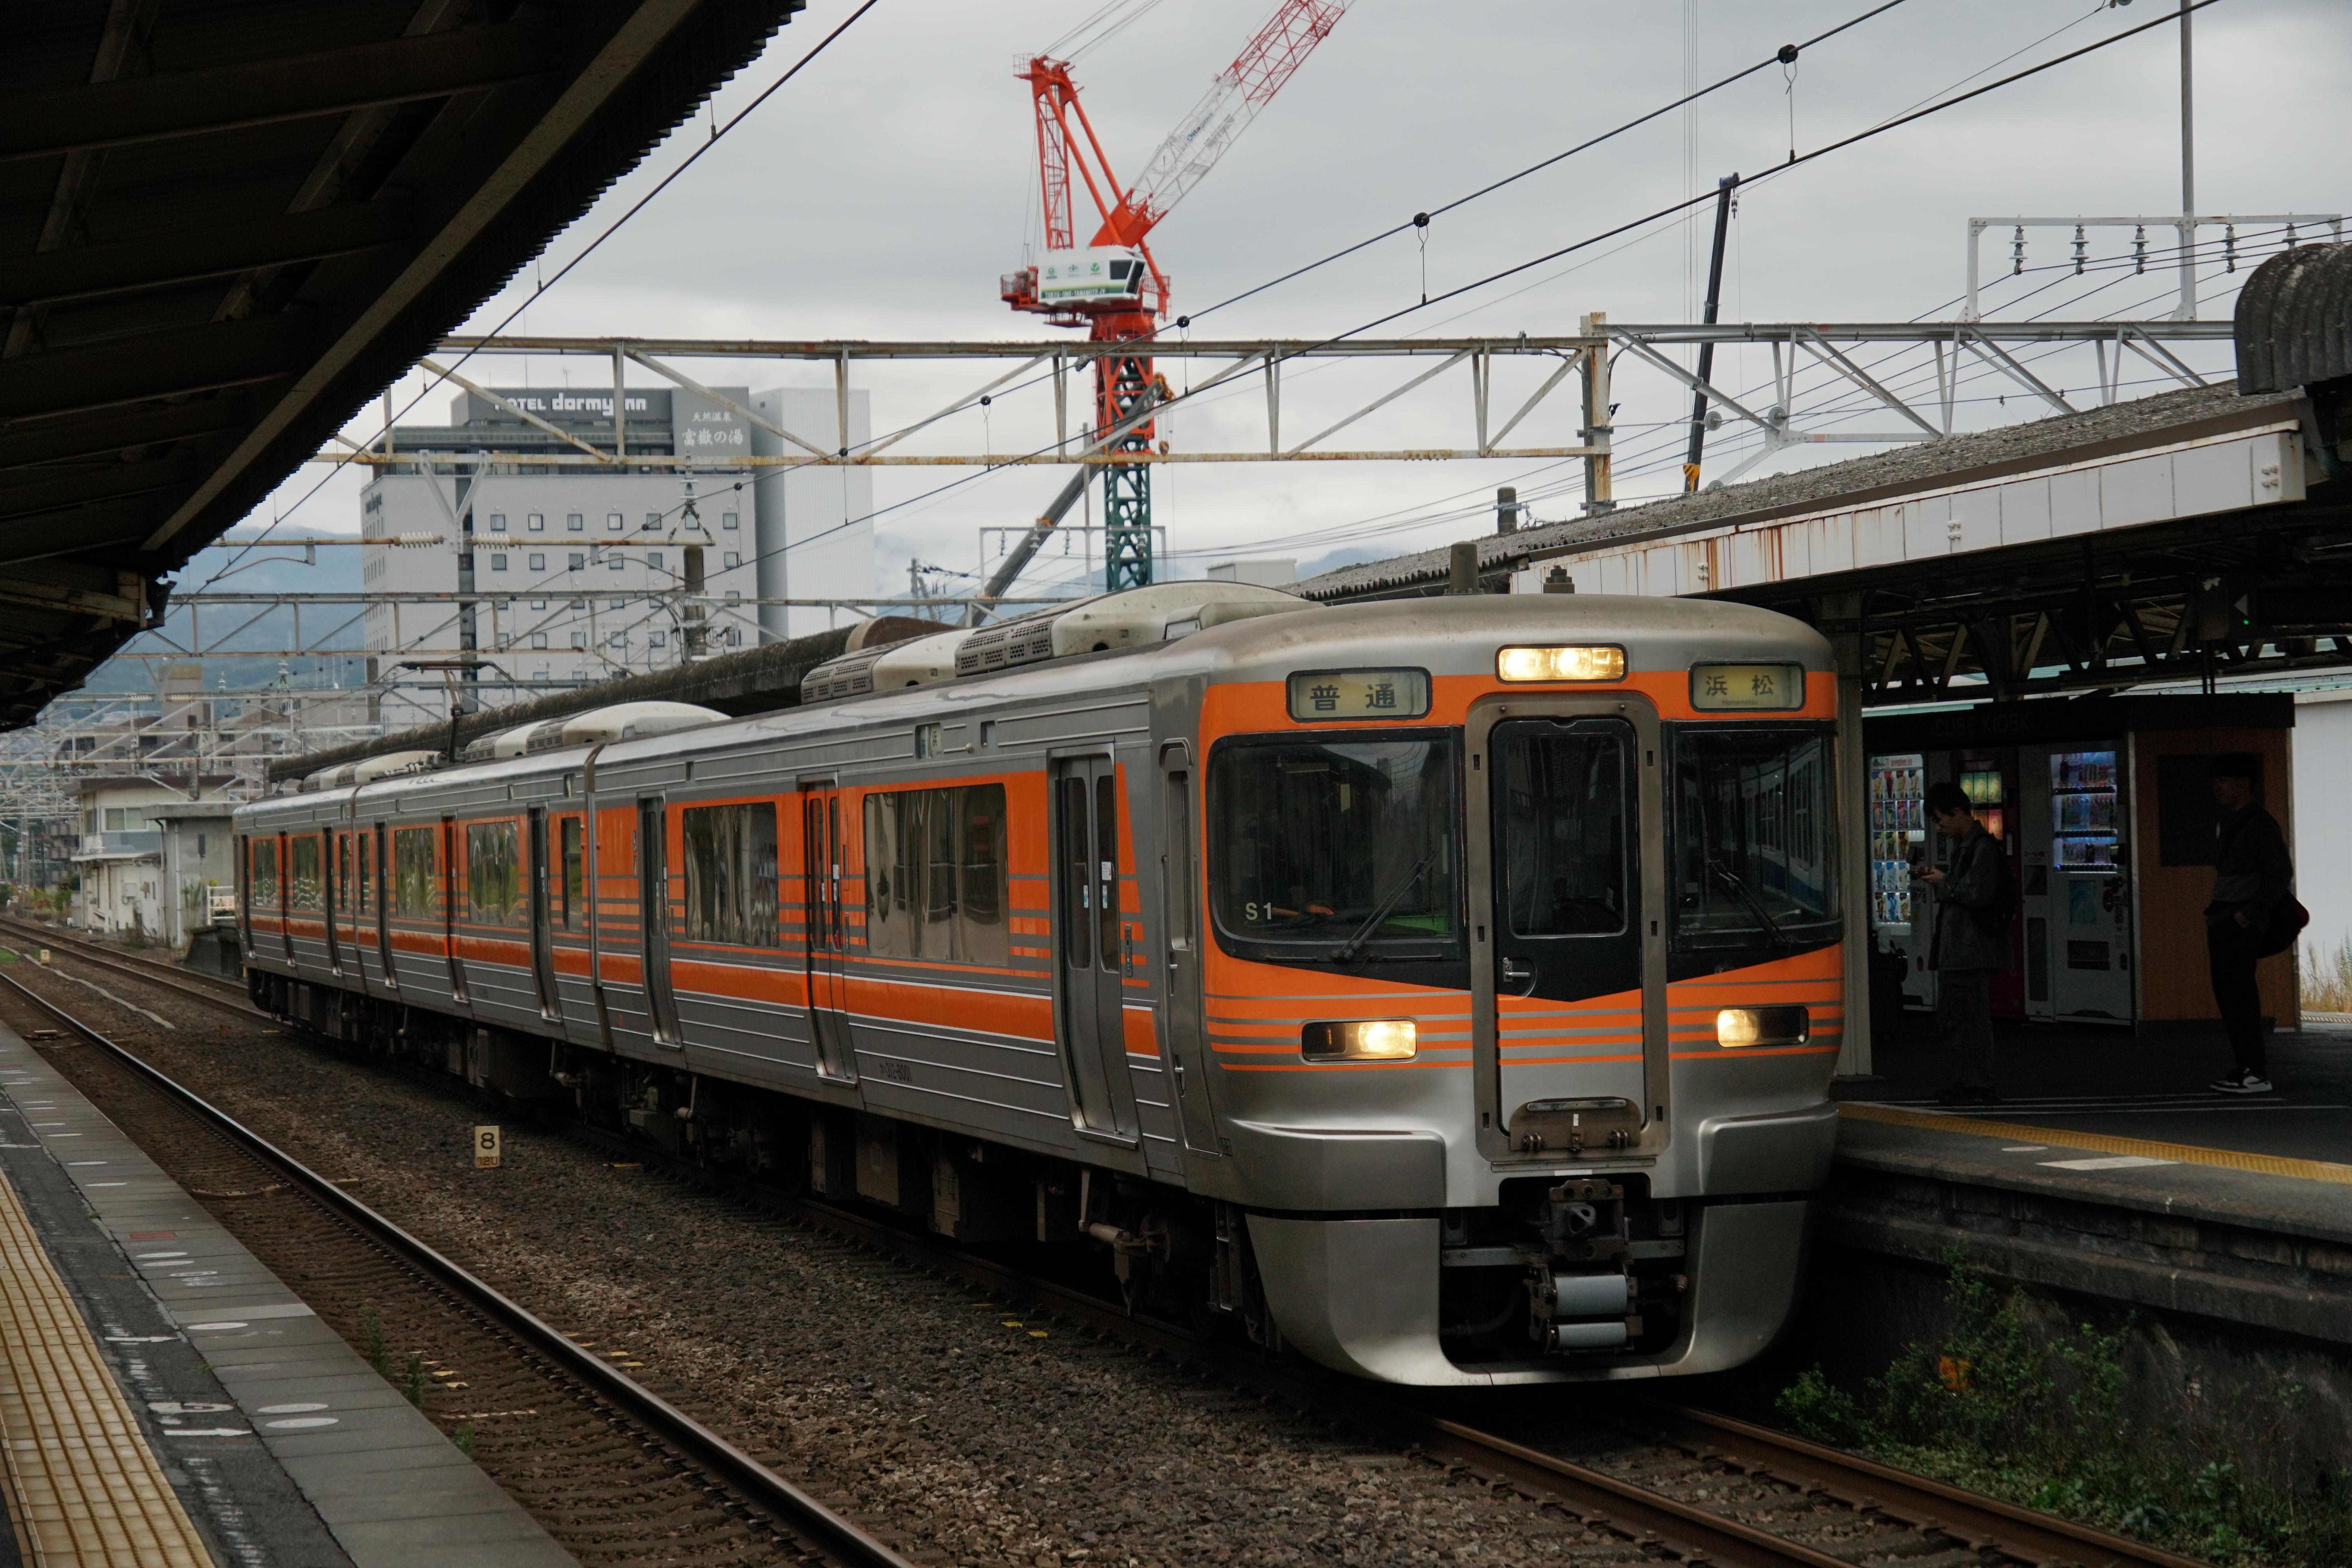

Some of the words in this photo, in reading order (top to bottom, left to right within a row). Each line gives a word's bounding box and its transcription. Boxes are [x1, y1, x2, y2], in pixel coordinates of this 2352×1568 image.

[552, 392, 614, 416] dormy
[692, 411, 731, 422] 天然温泉
[682, 428, 743, 446] 富嶽の湯
[1706, 674, 1775, 696] 浜松
[1310, 683, 1397, 711] 普通
[1936, 716, 1976, 737] CUBE
[1982, 712, 2030, 734] KIOSK
[1245, 902, 1271, 920] S1
[480, 1132, 495, 1149] 8
